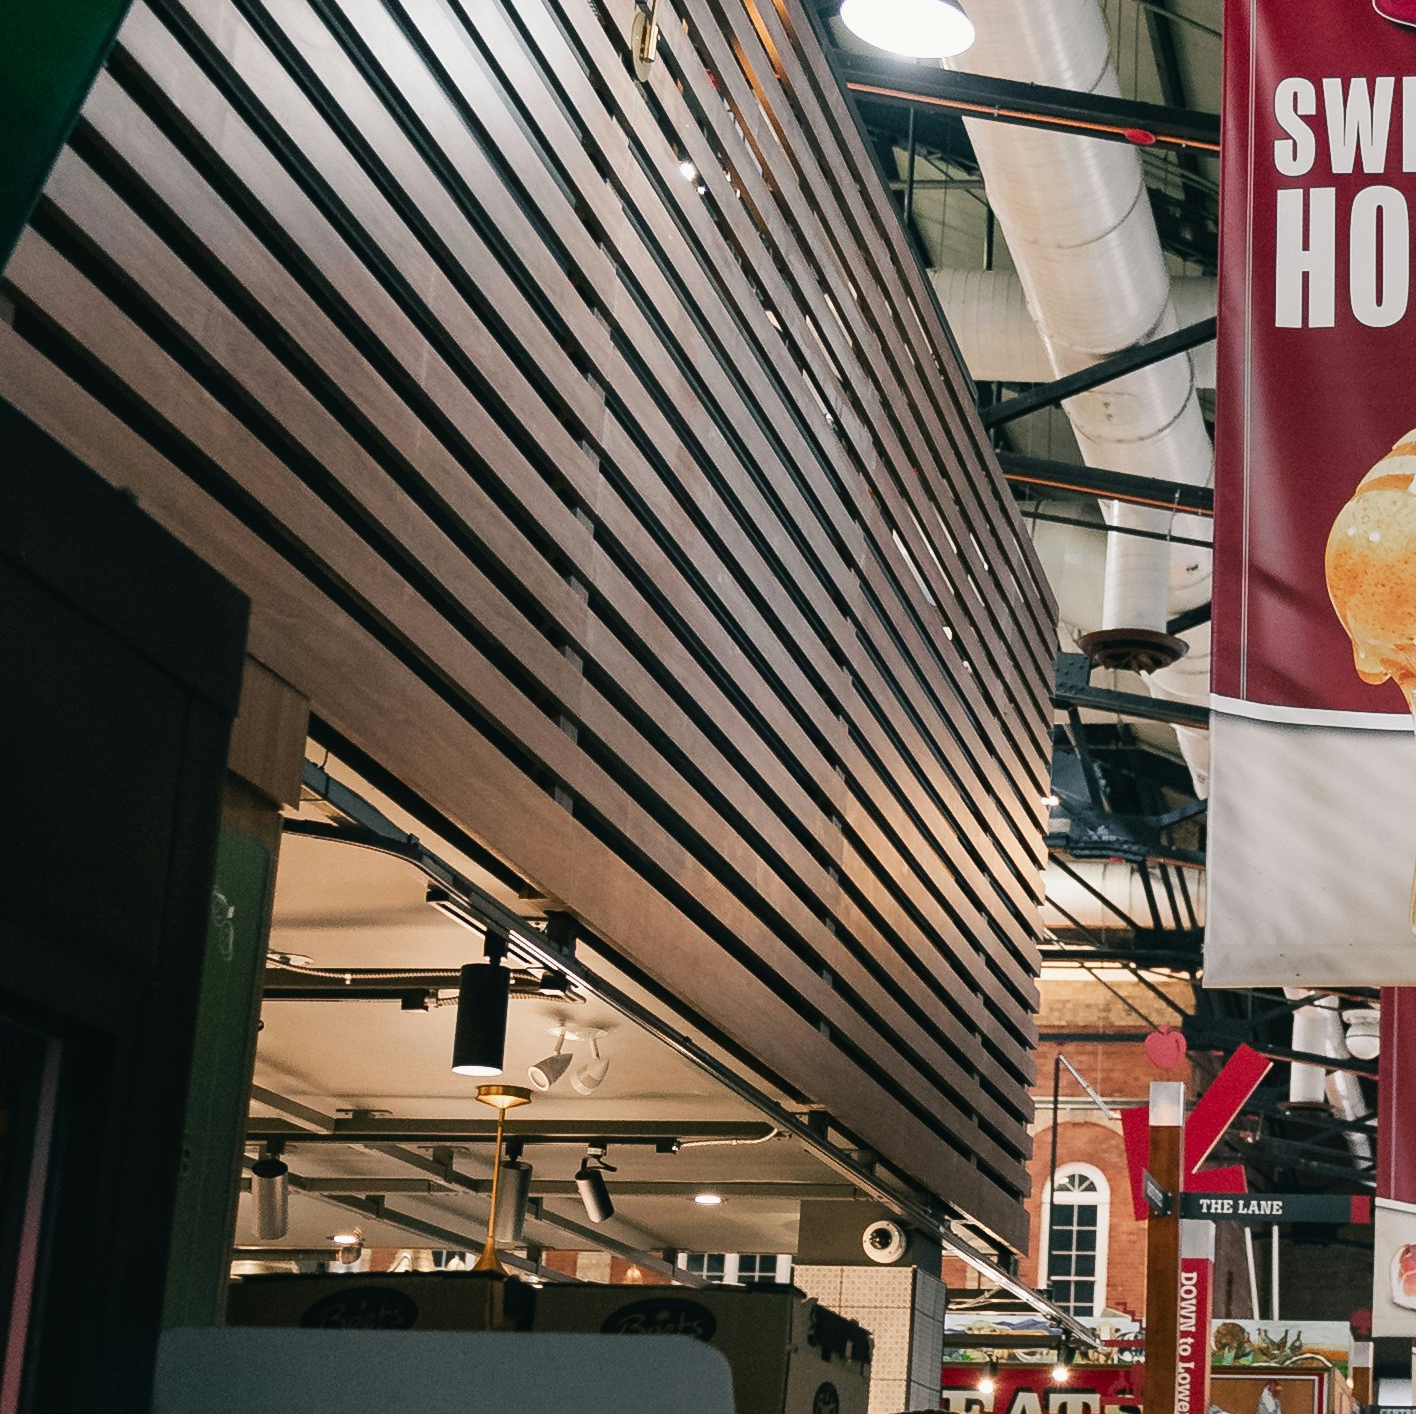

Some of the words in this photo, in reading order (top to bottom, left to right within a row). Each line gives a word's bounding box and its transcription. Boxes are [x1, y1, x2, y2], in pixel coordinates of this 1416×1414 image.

[1200, 1198, 1233, 1214] THE
[1238, 1200, 1283, 1216] LANE
[1179, 1270, 1198, 1333] DOWN
[1178, 1337, 1195, 1356] to
